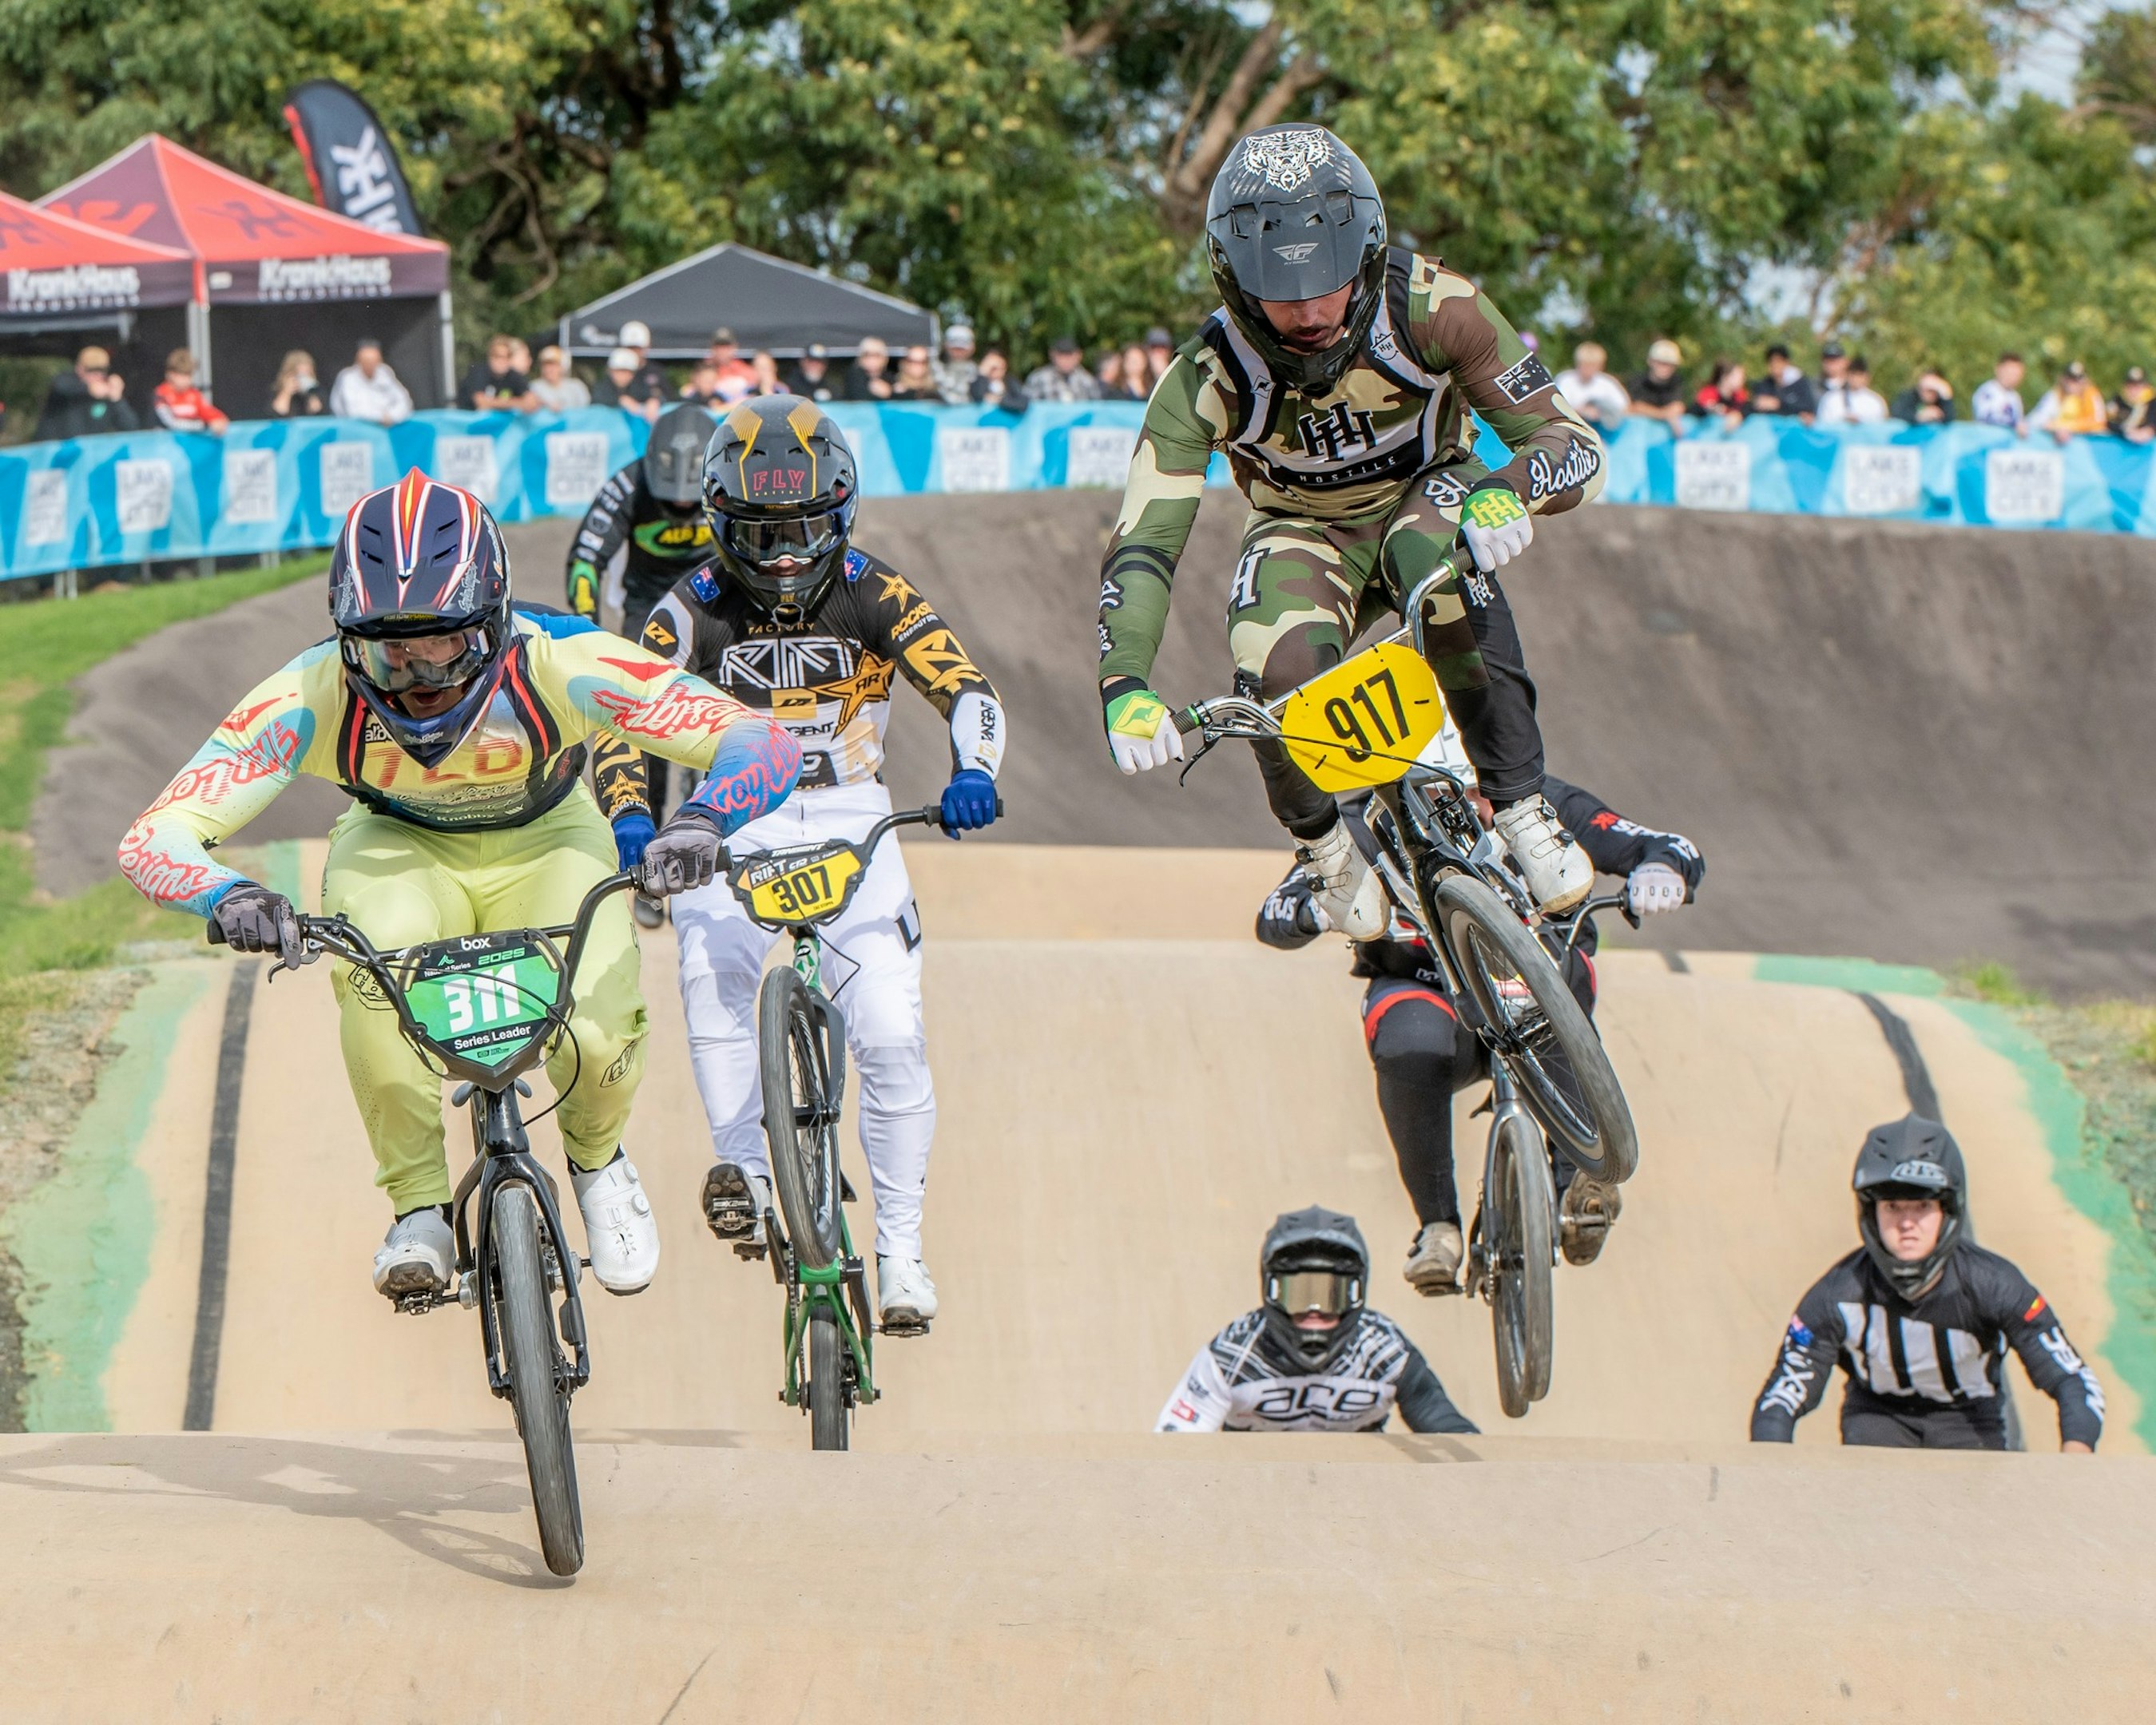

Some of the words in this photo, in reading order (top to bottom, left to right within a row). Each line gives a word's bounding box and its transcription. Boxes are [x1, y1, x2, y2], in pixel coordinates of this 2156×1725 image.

[753, 470, 805, 491] FLY
[1300, 455, 1396, 483] HOSTILE
[1530, 438, 1597, 498] Hostile
[748, 623, 815, 635] FACTORY
[891, 601, 934, 640] ROCKS
[1324, 668, 1410, 763] 917
[772, 864, 833, 914] 307
[460, 937, 492, 951] box
[478, 947, 526, 966] 2025
[443, 963, 521, 1034] 311
[454, 1035, 490, 1051] Series
[491, 1025, 532, 1042] Leader
[1254, 1383, 1380, 1418] ace
